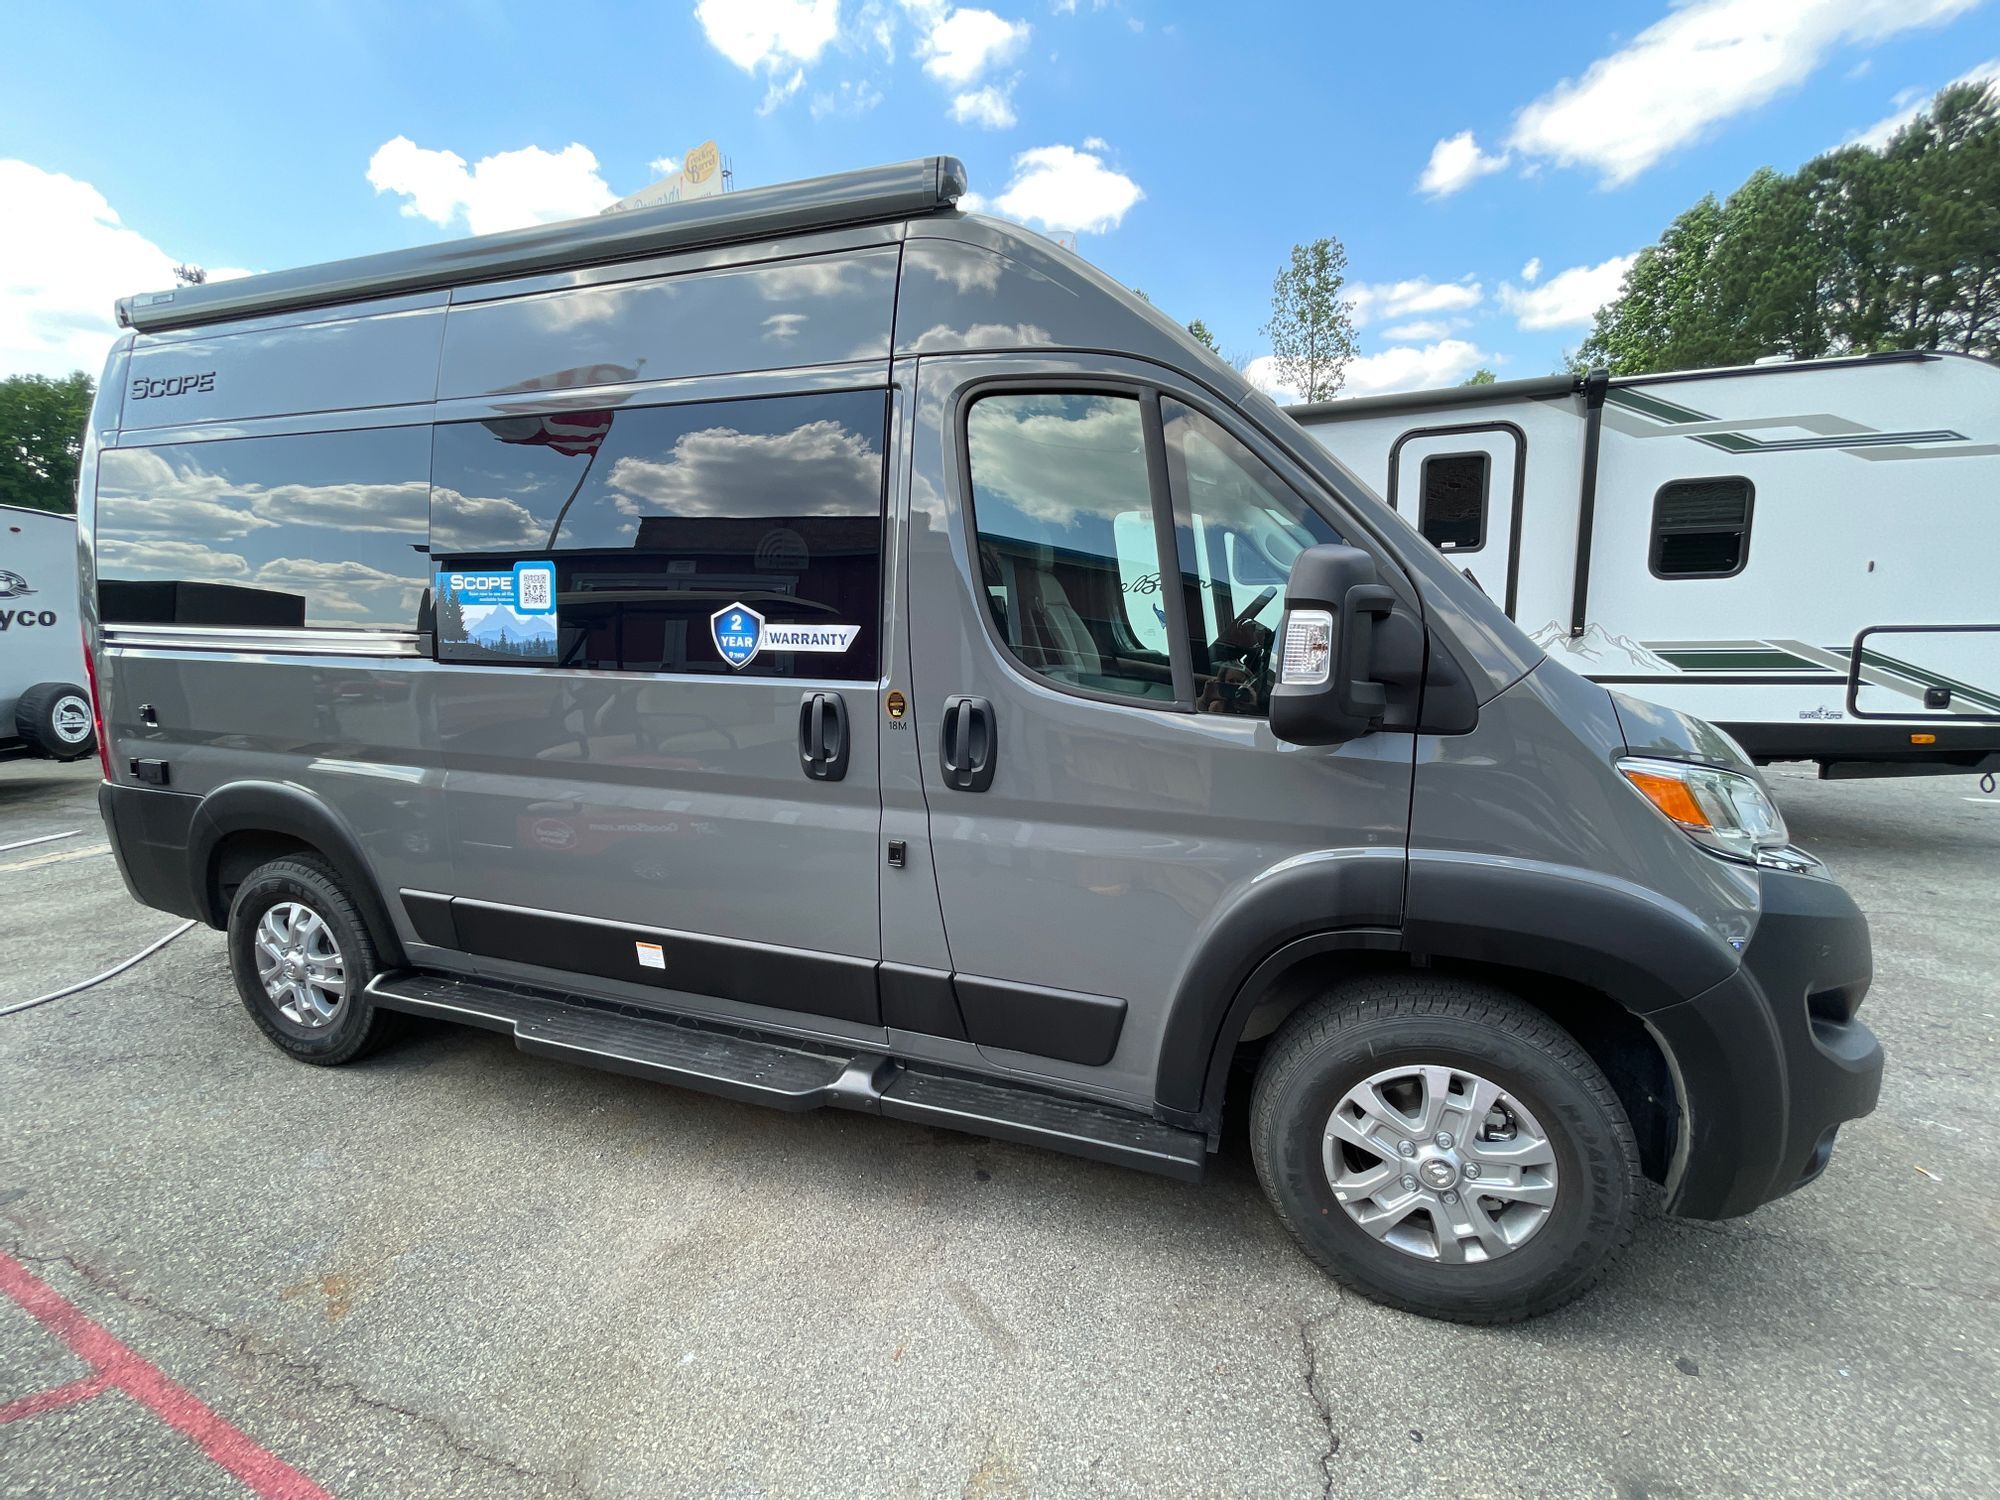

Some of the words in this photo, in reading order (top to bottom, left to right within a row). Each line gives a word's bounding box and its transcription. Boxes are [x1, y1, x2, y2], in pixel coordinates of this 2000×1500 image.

[131, 371, 217, 400] SCOPE
[450, 574, 513, 590] SCOPE
[730, 614, 742, 631] 2
[720, 635, 753, 648] YEAR
[769, 631, 848, 646] WARRANTY
[888, 721, 907, 731] 18M
